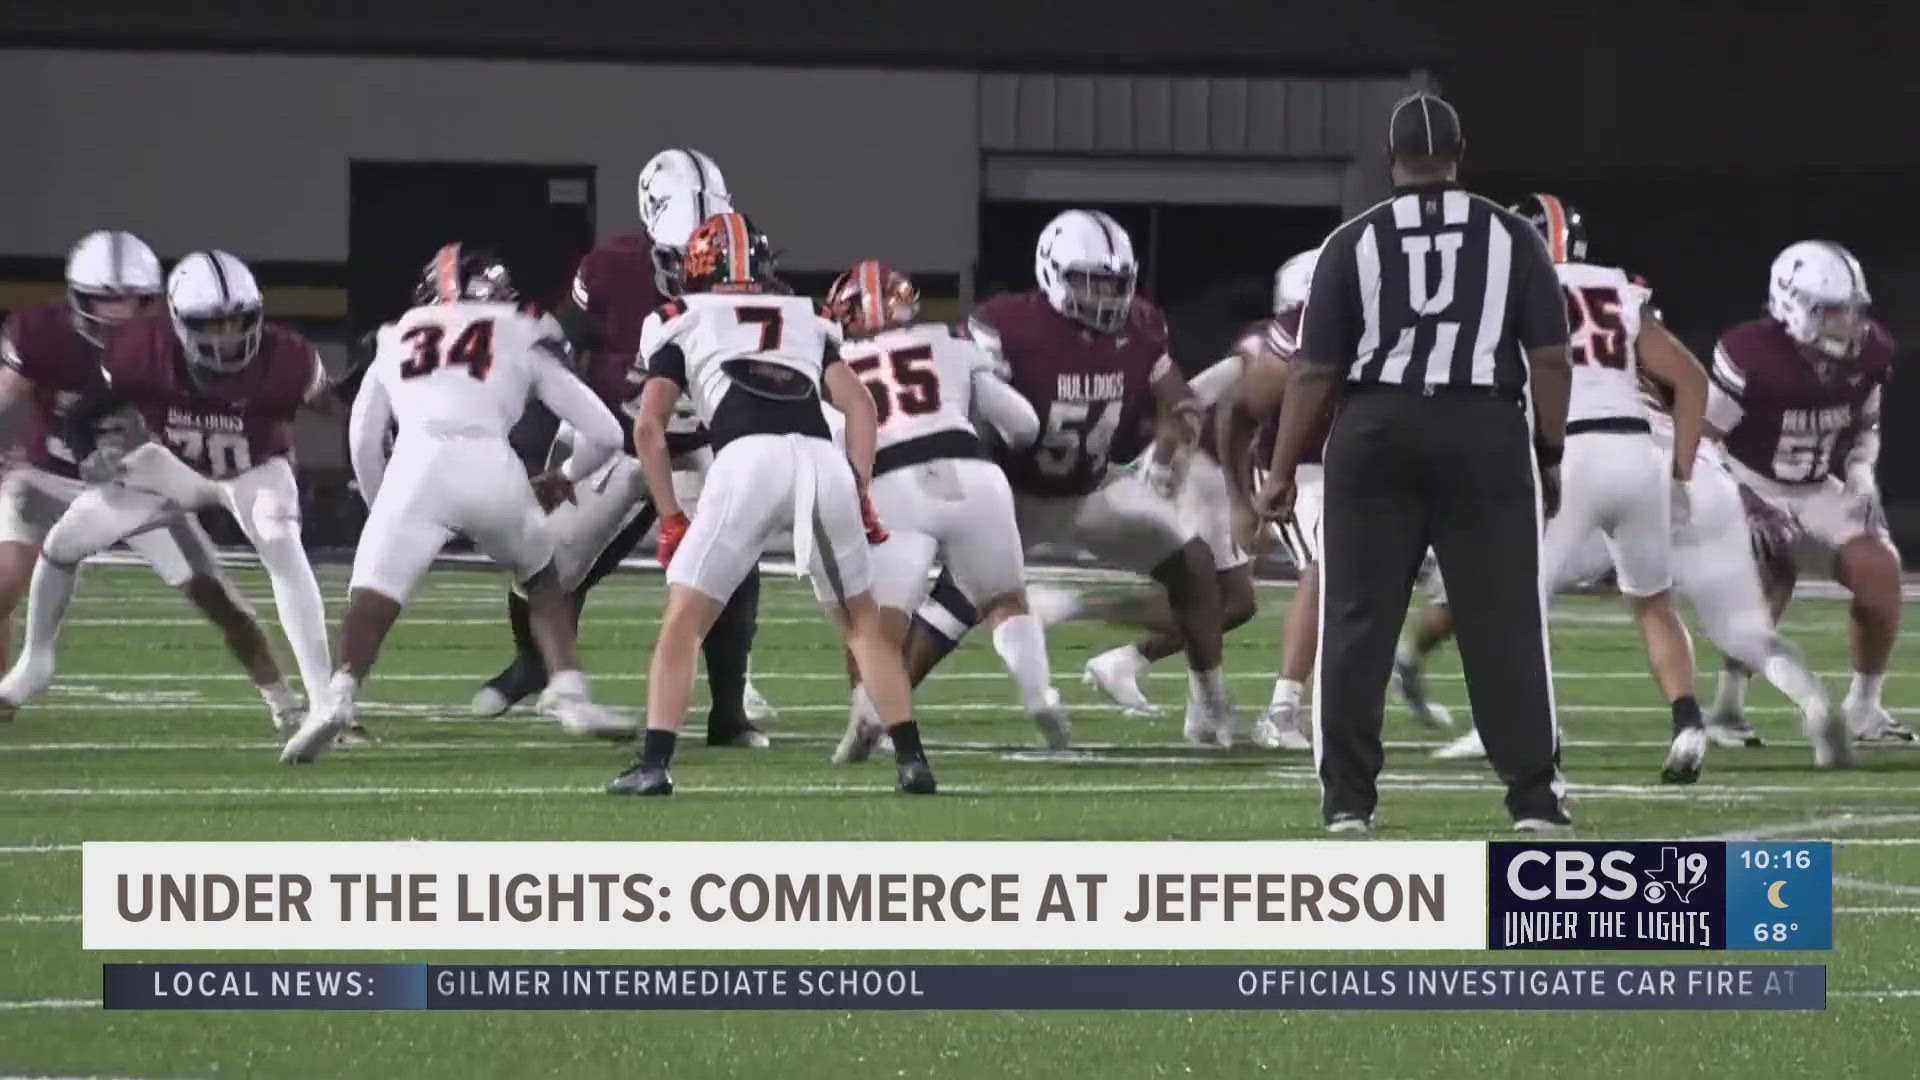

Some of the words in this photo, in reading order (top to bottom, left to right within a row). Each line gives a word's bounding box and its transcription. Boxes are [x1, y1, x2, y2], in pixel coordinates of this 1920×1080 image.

[1402, 232, 1463, 317] U
[400, 319, 496, 383] 34
[734, 306, 784, 352] 7
[1057, 370, 1125, 402] BULLDOGS
